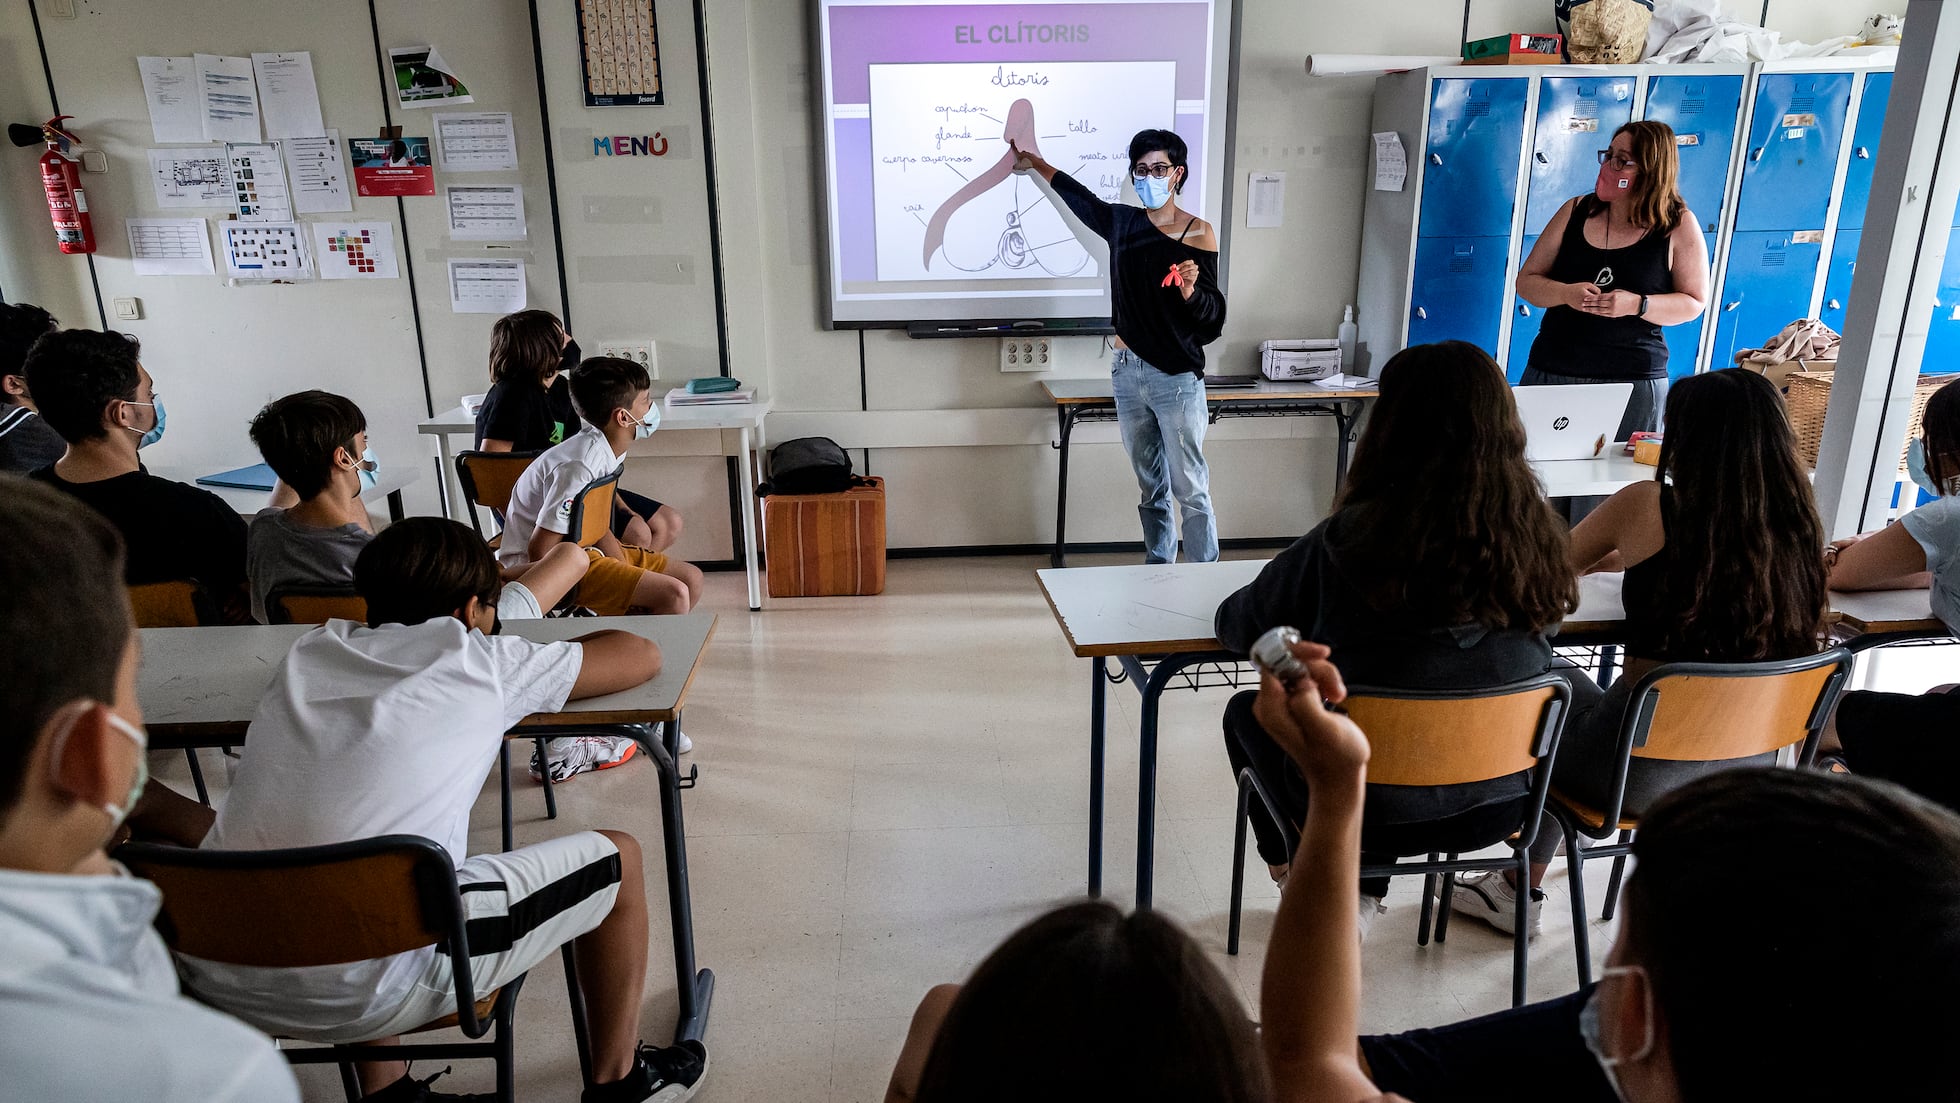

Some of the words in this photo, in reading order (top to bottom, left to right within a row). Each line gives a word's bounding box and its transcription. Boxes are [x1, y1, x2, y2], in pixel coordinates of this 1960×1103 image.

[955, 25, 982, 44] EL
[988, 20, 1090, 43] CLÍTORIS
[1068, 119, 1097, 133] tallo
[593, 132, 668, 156] MENÚ
[935, 126, 972, 150] glande
[882, 156, 917, 173] cuerpo
[921, 156, 973, 164] cavernoso
[1553, 416, 1569, 431] hp
